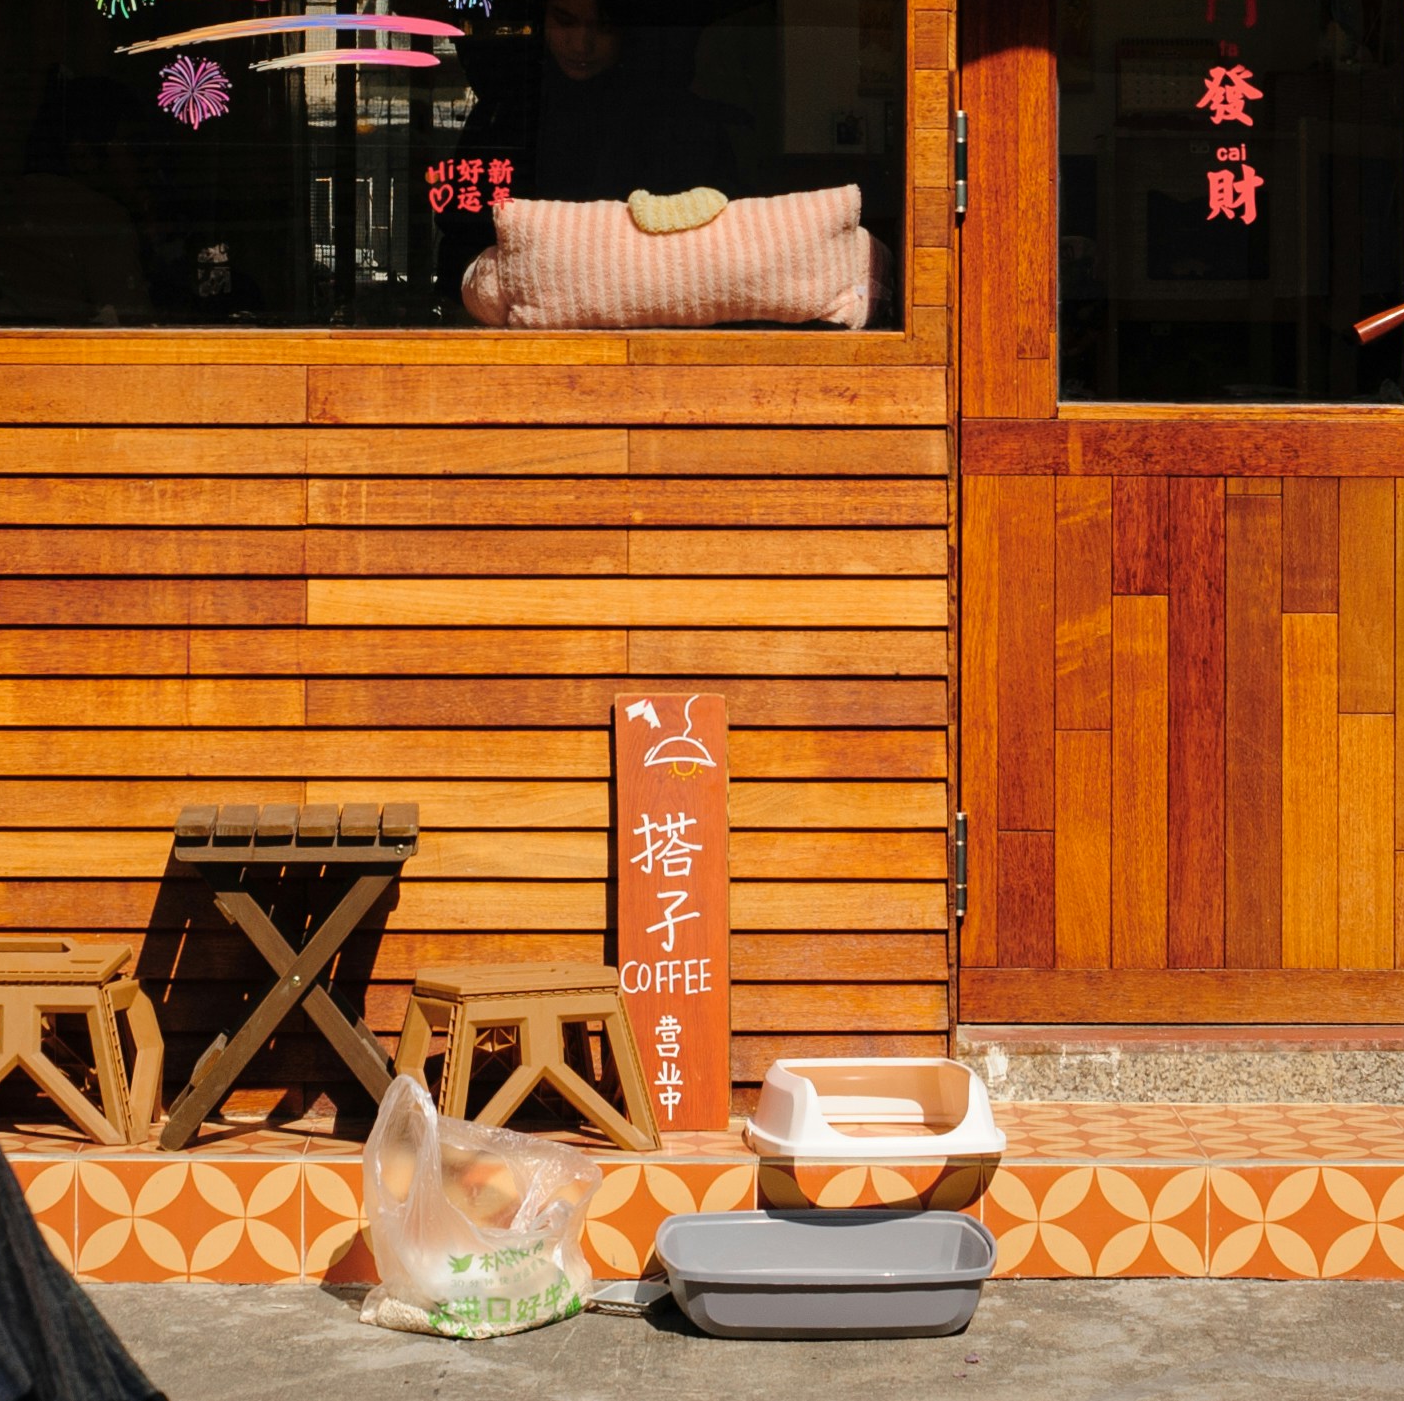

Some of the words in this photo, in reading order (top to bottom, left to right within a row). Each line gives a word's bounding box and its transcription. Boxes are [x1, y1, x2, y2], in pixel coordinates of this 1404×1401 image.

[427, 158, 455, 185] Hi
[1216, 144, 1247, 161] cai
[629, 811, 703, 953] 搭子
[620, 957, 712, 995] COFFEE
[653, 1014, 683, 1122] 营业中
